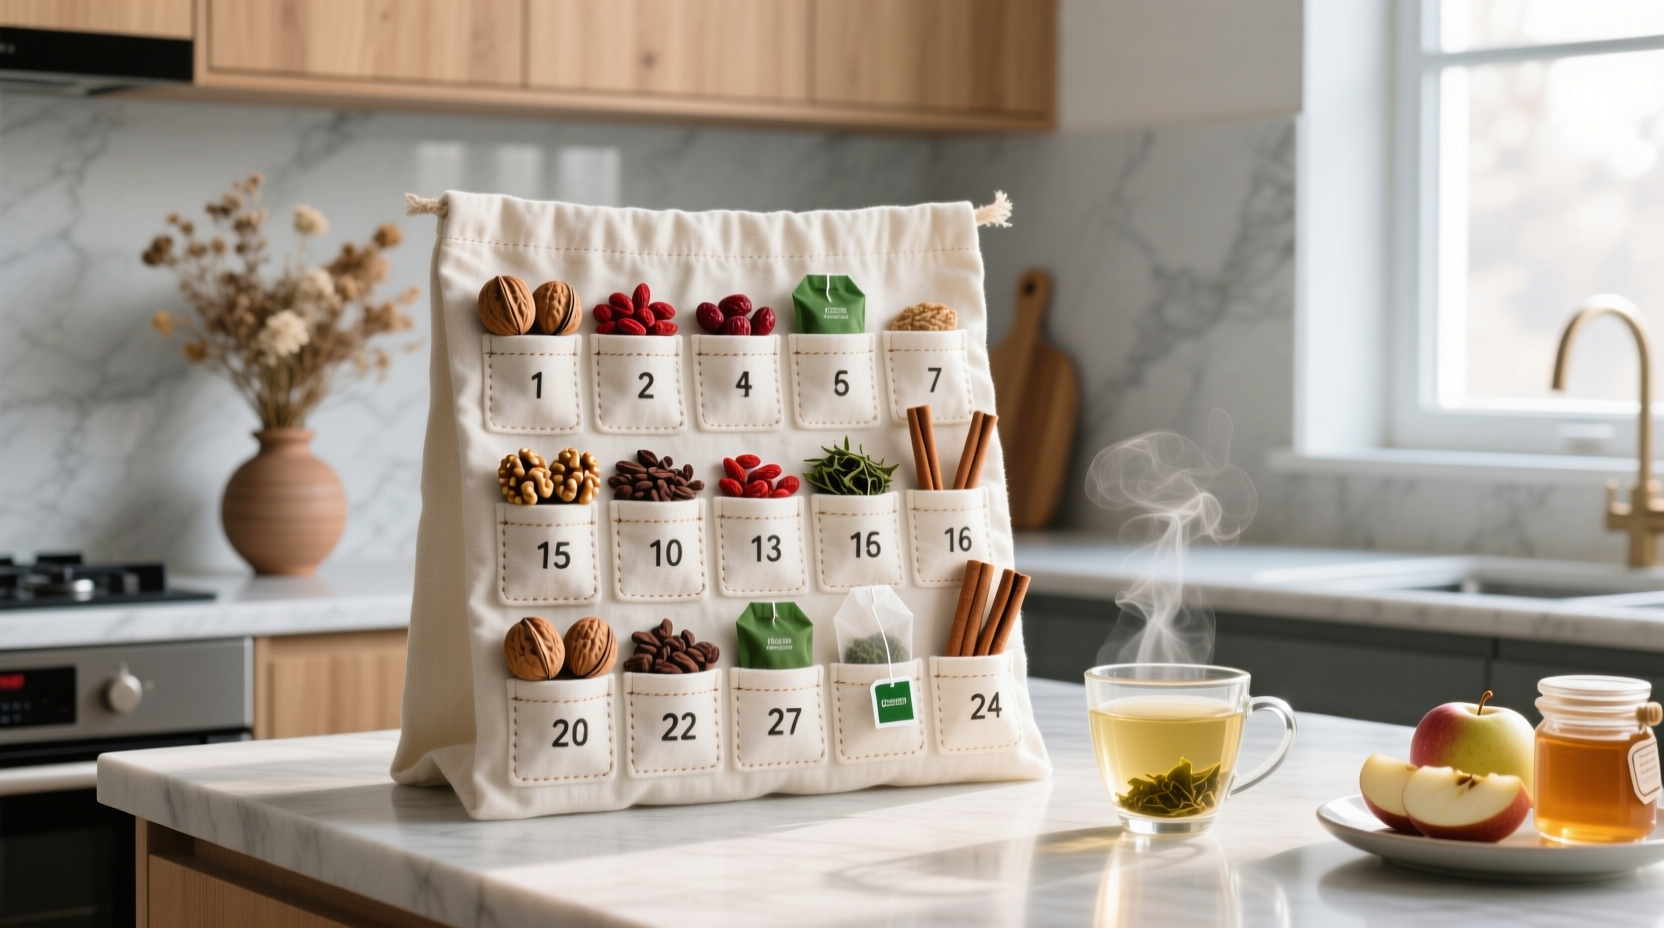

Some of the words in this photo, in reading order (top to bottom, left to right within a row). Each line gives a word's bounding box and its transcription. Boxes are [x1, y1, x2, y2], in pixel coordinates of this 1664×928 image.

[531, 371, 543, 400] 1
[637, 371, 654, 399] 2
[735, 371, 753, 398] 4
[927, 367, 942, 393] 7
[649, 539, 683, 567] 10
[751, 534, 782, 563] 13
[944, 526, 972, 553] 16
[536, 540, 571, 570] 15
[970, 691, 1002, 720] 24
[551, 718, 588, 748] 20
[661, 712, 697, 742] 22
[767, 707, 802, 736] 27
